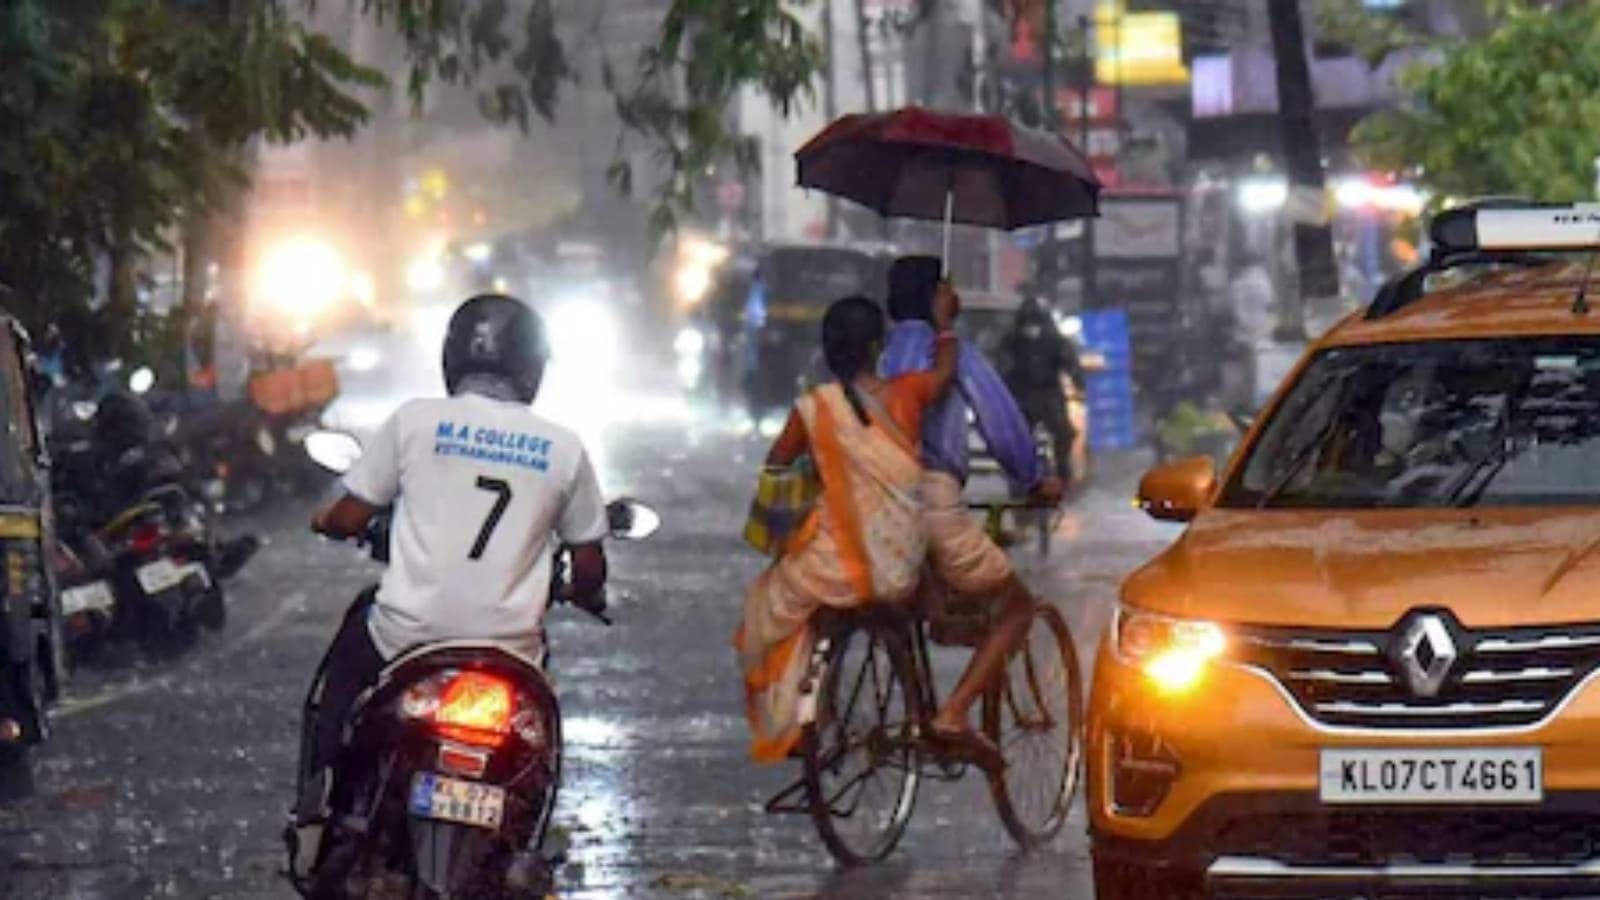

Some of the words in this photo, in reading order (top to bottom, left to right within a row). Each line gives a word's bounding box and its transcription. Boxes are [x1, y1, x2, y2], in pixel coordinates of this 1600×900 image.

[475, 427, 554, 455] COLLEGE
[467, 475, 512, 561] 7
[1341, 759, 1535, 791] KL07CT4661
